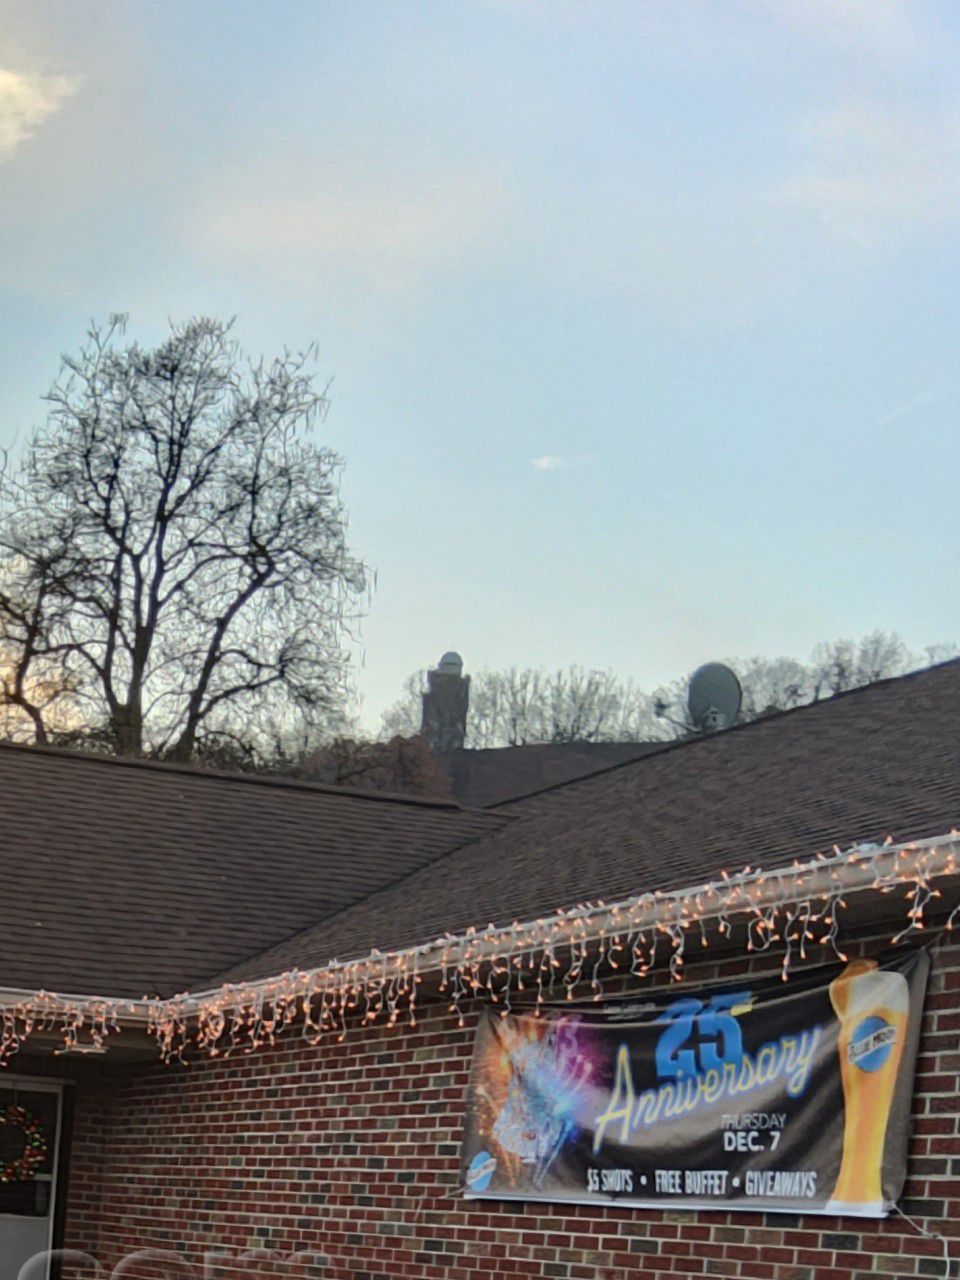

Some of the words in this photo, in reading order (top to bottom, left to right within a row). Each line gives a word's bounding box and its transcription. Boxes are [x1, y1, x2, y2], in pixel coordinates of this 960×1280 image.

[655, 991, 753, 1079] 25
[593, 1026, 821, 1154] Anniversary
[721, 1112, 787, 1130] THURSDAY
[723, 1131, 765, 1152] DEC.
[769, 1131, 781, 1152] 7
[601, 1169, 633, 1194] SHOTS
[655, 1169, 683, 1194] FREE
[685, 1170, 729, 1195] BUFFET
[745, 1170, 818, 1198] GIVEAWAYS
